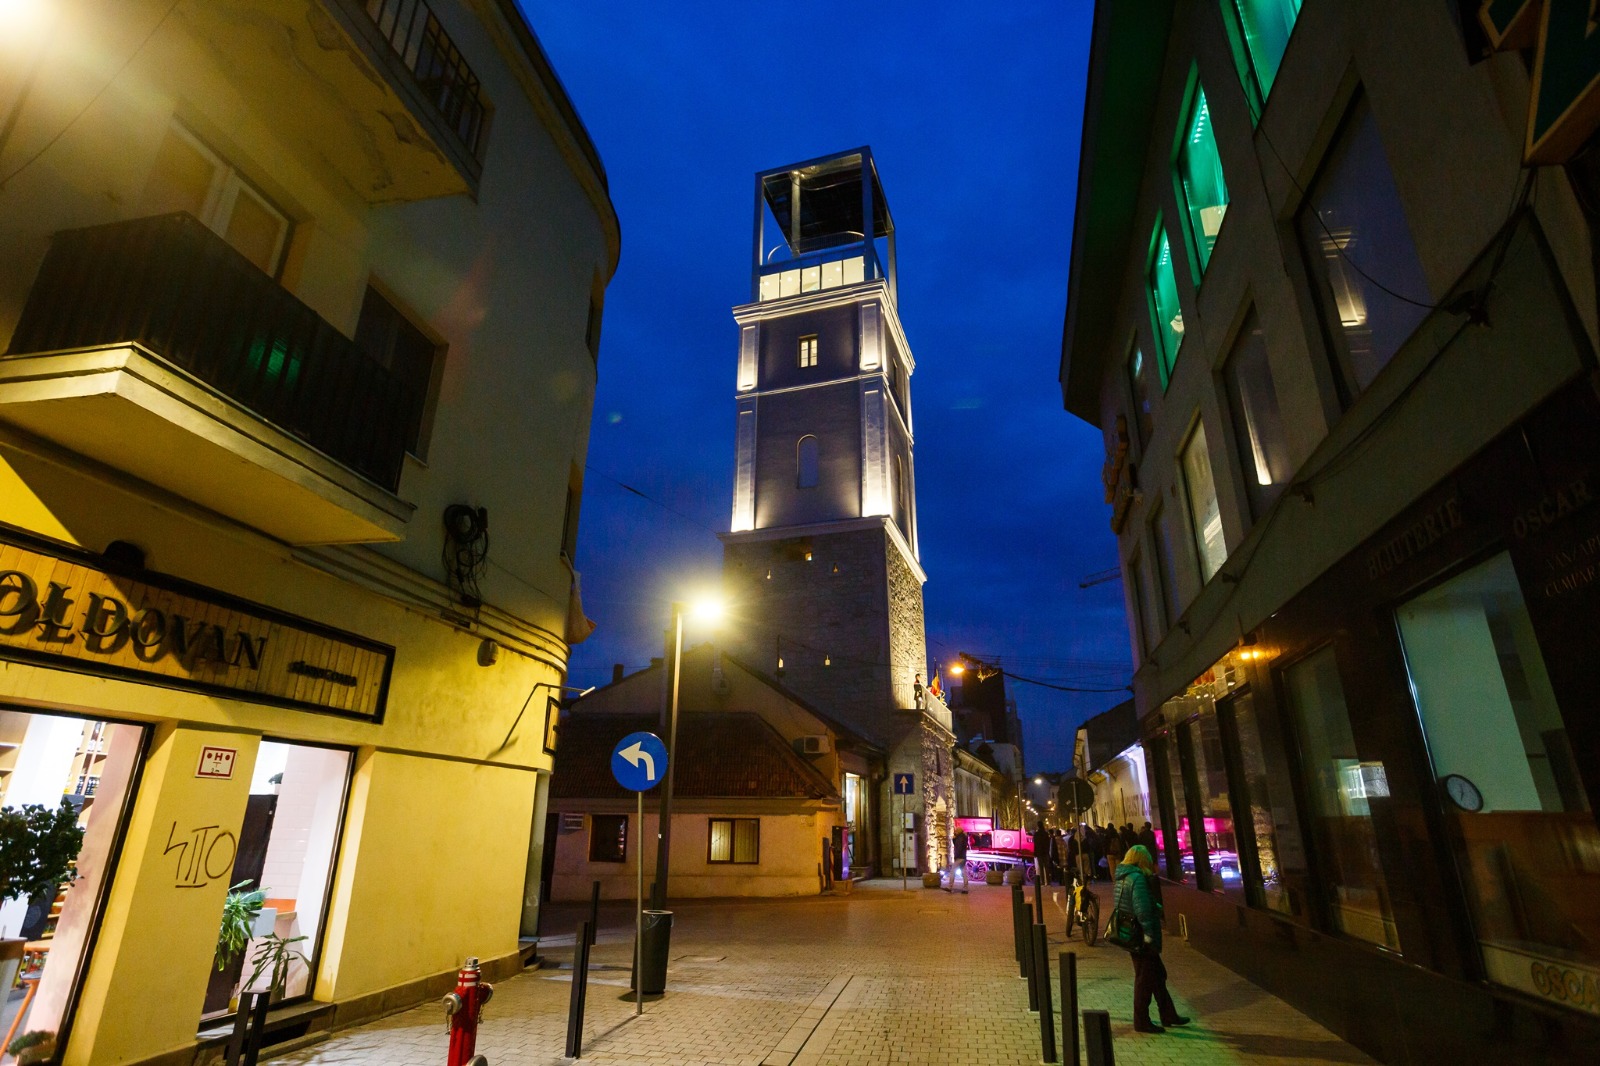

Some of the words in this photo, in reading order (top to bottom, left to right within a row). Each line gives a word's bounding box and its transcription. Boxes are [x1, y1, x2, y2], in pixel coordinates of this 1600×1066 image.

[1513, 480, 1592, 538] OSCAR
[1367, 497, 1462, 580] BIJUTERIE
[1545, 562, 1600, 597] CUMPAR
[214, 752, 223, 761] H
[1531, 961, 1600, 1009] OSCA
